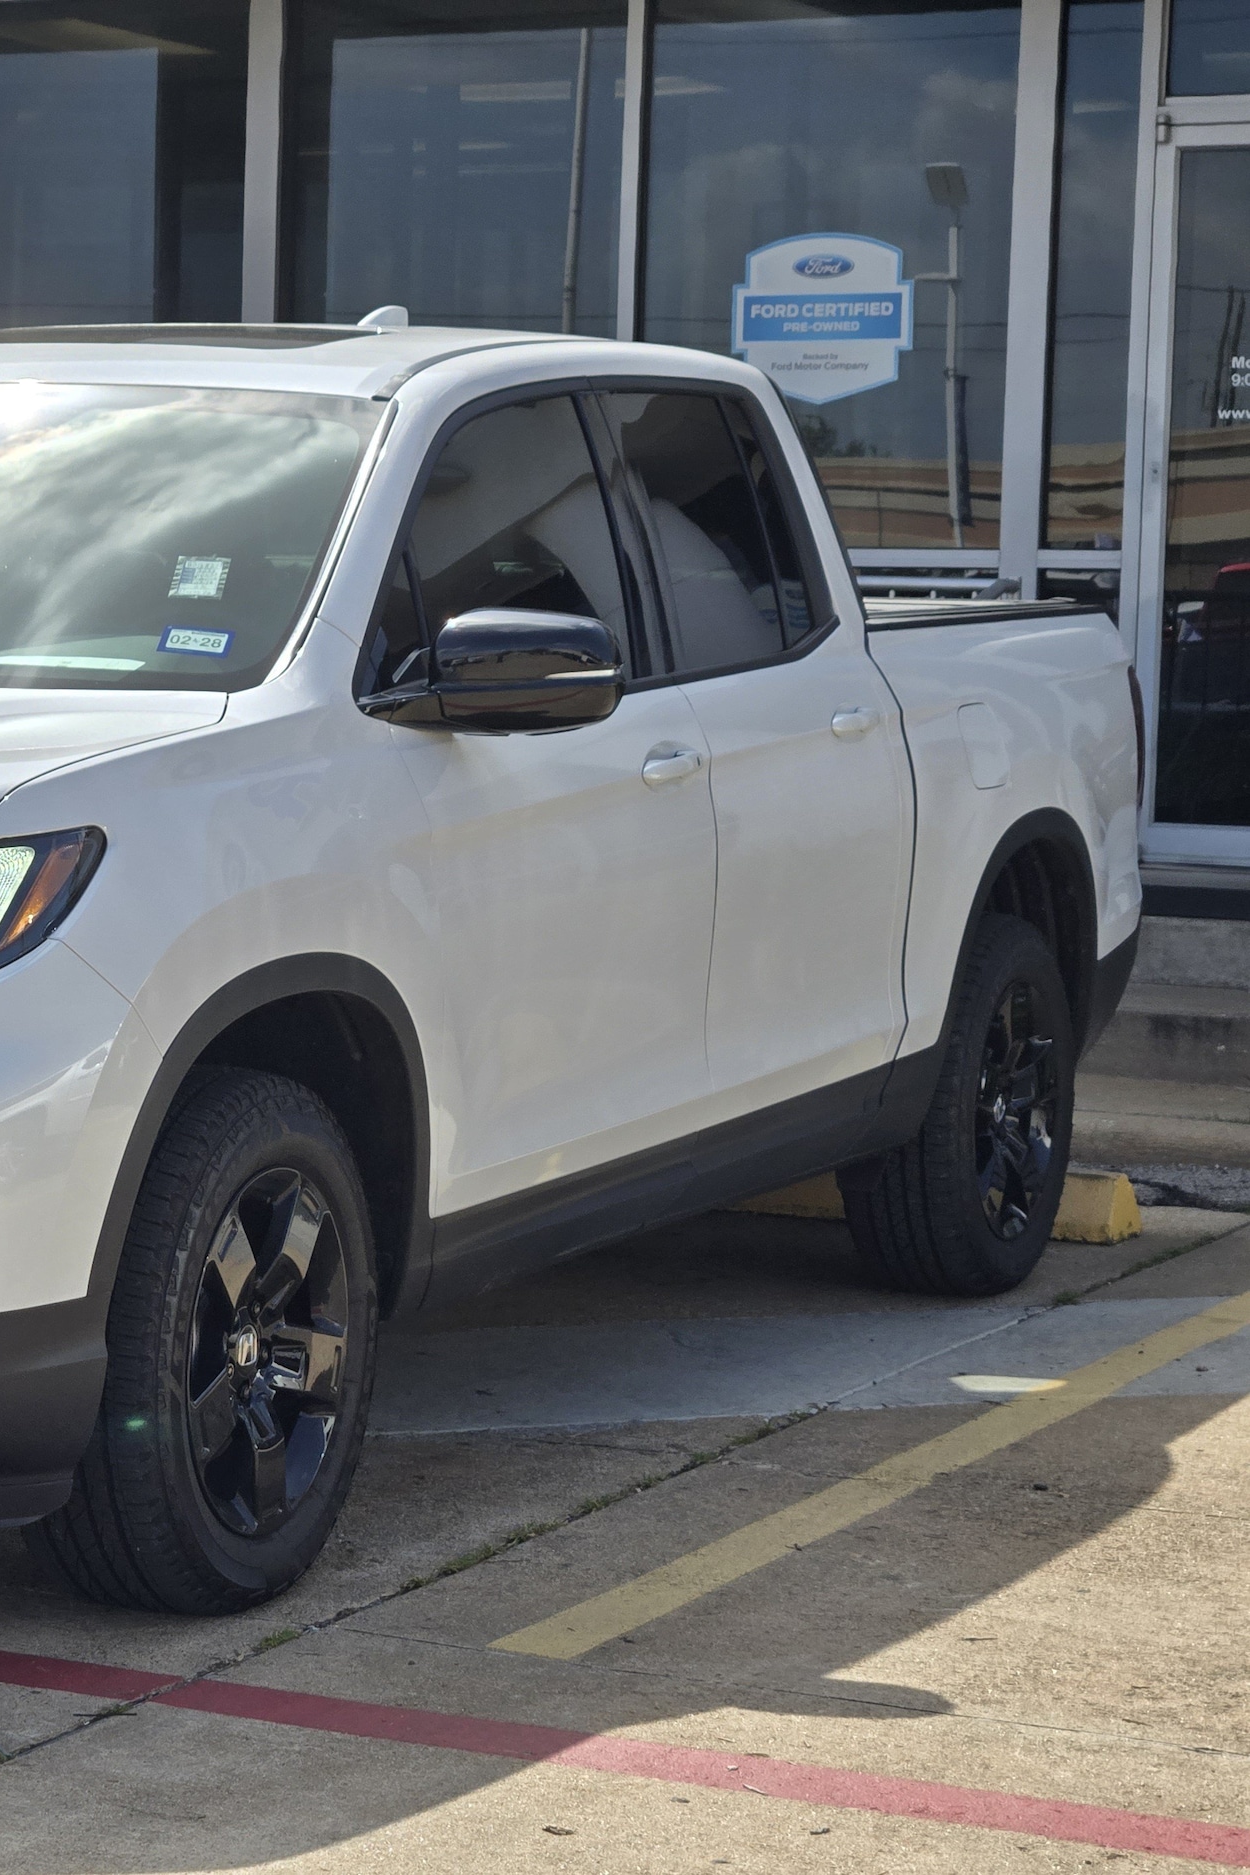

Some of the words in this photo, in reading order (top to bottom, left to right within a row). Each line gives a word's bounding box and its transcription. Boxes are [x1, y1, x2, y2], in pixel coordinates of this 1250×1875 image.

[804, 258, 842, 275] Ford
[750, 304, 799, 319] FORD
[802, 301, 894, 317] CERTIFIED
[783, 321, 860, 332] PRE-OWNED
[771, 362, 792, 371] Ford
[794, 362, 822, 371] Motor
[824, 361, 869, 373] Company
